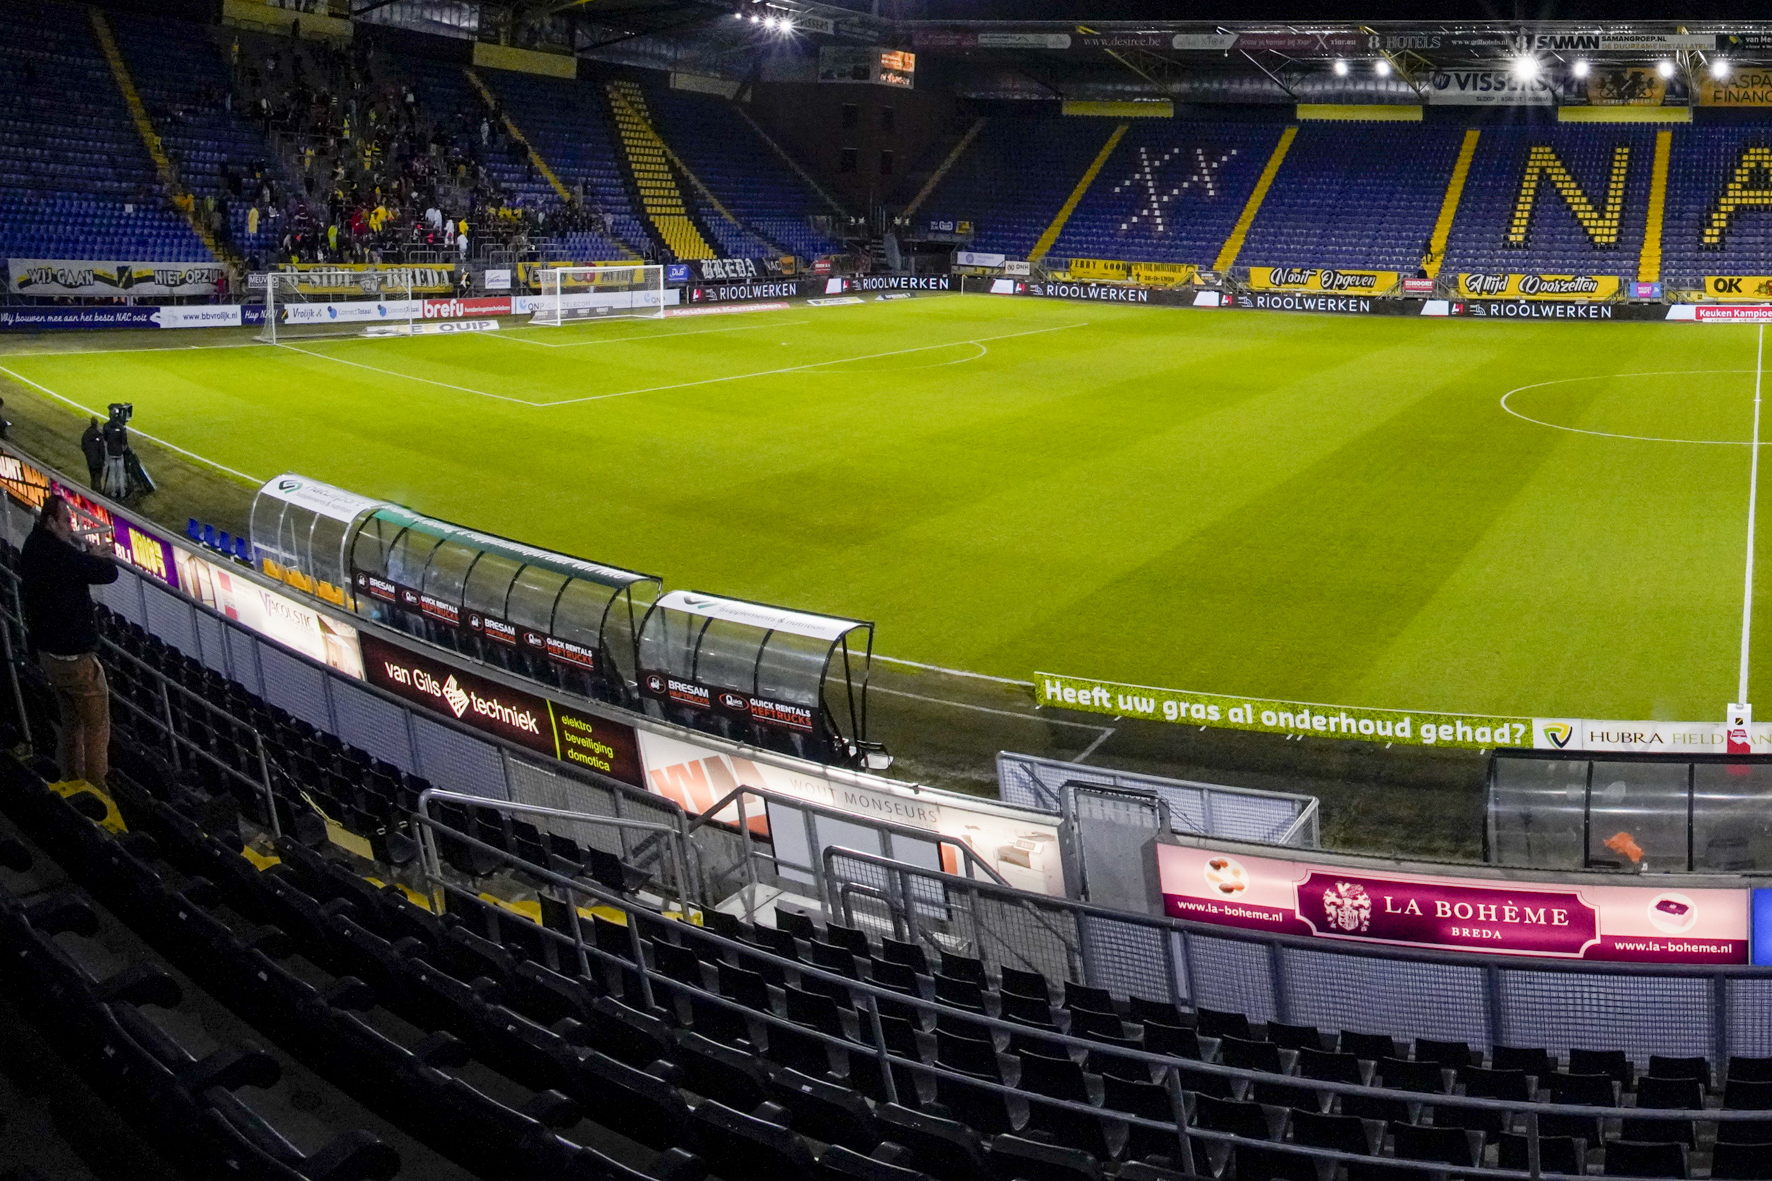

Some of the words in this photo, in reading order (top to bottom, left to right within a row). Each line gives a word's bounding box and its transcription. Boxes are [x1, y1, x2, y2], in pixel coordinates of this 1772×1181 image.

[1386, 35, 1442, 49] HOTELS
[1535, 35, 1600, 50] SAMAN
[57, 269, 95, 287] GAAN
[154, 269, 184, 286] NIET
[862, 276, 950, 291] RIOOLWERKEN
[1320, 267, 1378, 290] Opgeven
[1465, 273, 1509, 295] Altijd
[1518, 274, 1598, 296] Doorzetten
[1713, 277, 1743, 294] OK
[719, 282, 798, 301] RIOOLWERKEN
[1045, 283, 1149, 303] RIOOLWERKEN
[423, 298, 465, 319] brefu
[1256, 294, 1371, 313] RIOOLWERKEN
[1490, 302, 1612, 319] RIOOLWERKEN
[15, 313, 46, 324] bouwen
[64, 314, 79, 324] aan
[80, 312, 94, 323] het
[95, 312, 115, 323] beste
[1700, 308, 1735, 319] Keuken
[484, 617, 516, 636] BRESAM
[384, 659, 412, 684] van
[412, 666, 442, 698] Gils
[470, 688, 541, 736] techniek
[667, 679, 710, 698] BRESAM
[749, 697, 774, 710] QUICK
[775, 703, 812, 718] RENTALS
[750, 706, 812, 727] HEFTRUCKS
[1044, 680, 1113, 709] Heeft
[1117, 693, 1156, 713] uw
[1161, 699, 1222, 726] gras
[1227, 703, 1254, 725] al
[1261, 708, 1413, 740] onderhoud
[1419, 721, 1527, 748] gehad?
[561, 714, 594, 733] elektro
[564, 730, 614, 759] beveiliging
[1589, 729, 1665, 745] HUBRA
[1671, 732, 1727, 747] FIELD
[567, 747, 612, 773] domotica
[843, 790, 940, 825] MONSEURS
[1177, 899, 1284, 924] www.la-boheme.nl
[1384, 895, 1424, 917] LA
[1432, 898, 1571, 928] BOHÈME
[1450, 926, 1504, 941] BREDA
[1613, 939, 1734, 955] www.la-boheme.nl
